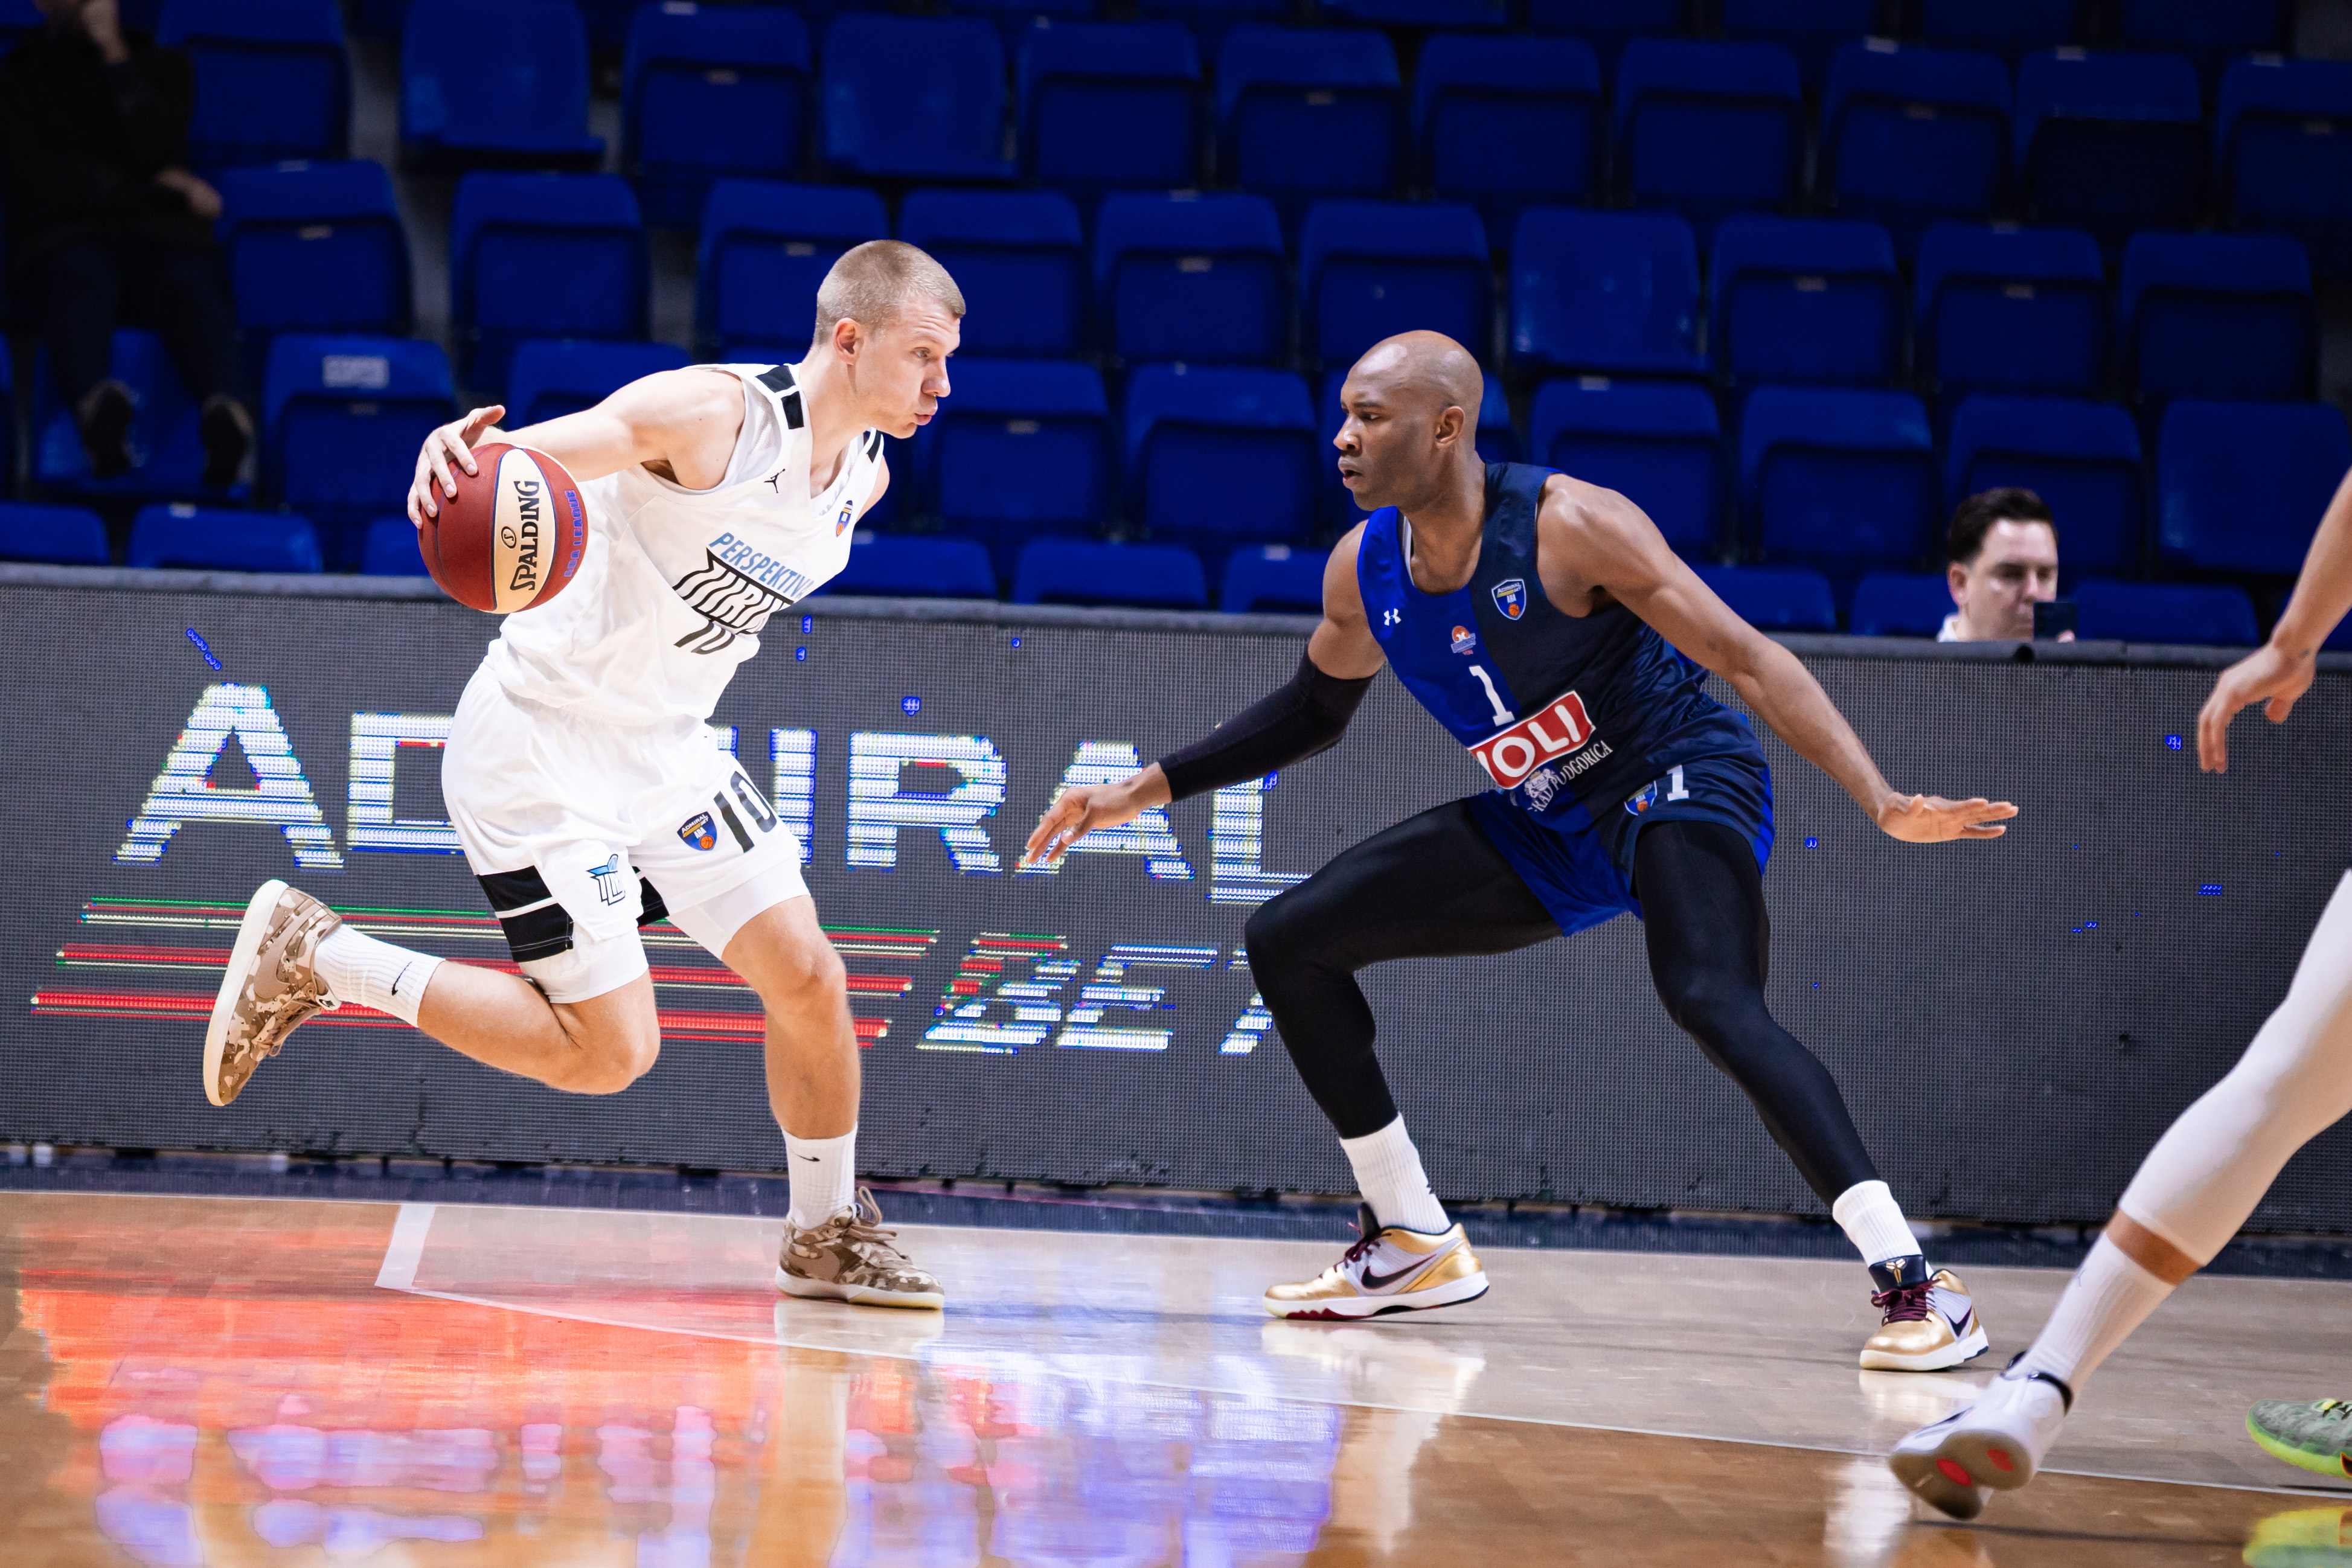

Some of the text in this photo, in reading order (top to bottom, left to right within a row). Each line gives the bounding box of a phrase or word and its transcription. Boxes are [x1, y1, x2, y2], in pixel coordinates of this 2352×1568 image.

[510, 481, 540, 591] SPALDING
[564, 490, 583, 546] LEAGUE
[1469, 665, 1515, 726] 1
[112, 682, 1313, 905] ADIRAL
[713, 770, 777, 853] 10
[1666, 764, 1689, 801] 1
[681, 814, 708, 834] ADMIRAL
